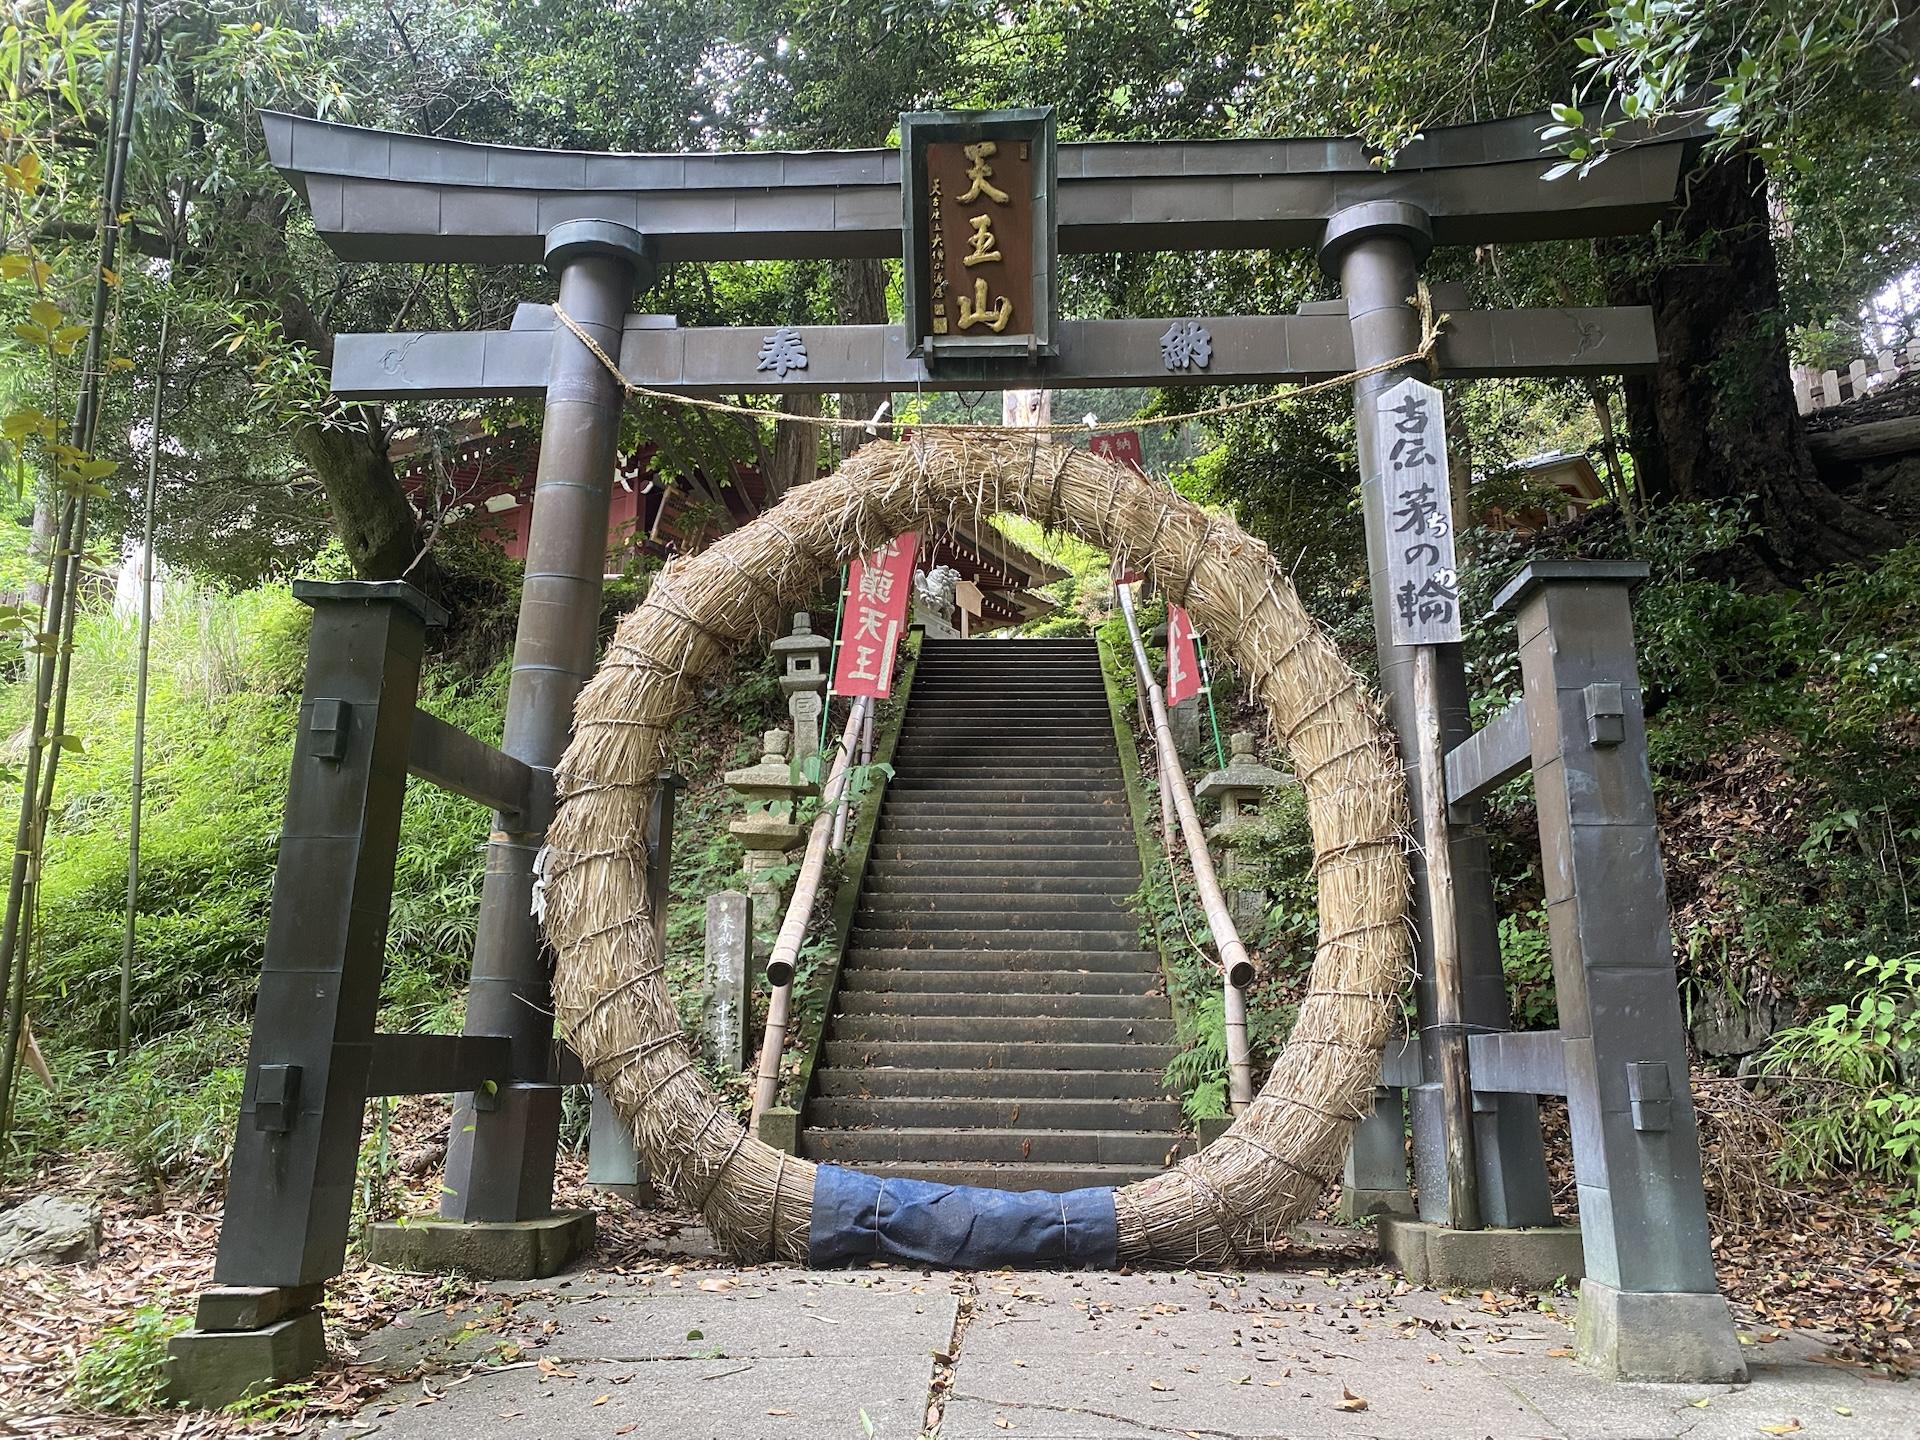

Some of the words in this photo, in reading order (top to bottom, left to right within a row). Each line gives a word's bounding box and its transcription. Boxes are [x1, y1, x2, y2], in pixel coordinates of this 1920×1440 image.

[756, 328, 808, 377] 奉
[1160, 321, 1212, 369] 納
[1427, 511, 1448, 539] ち
